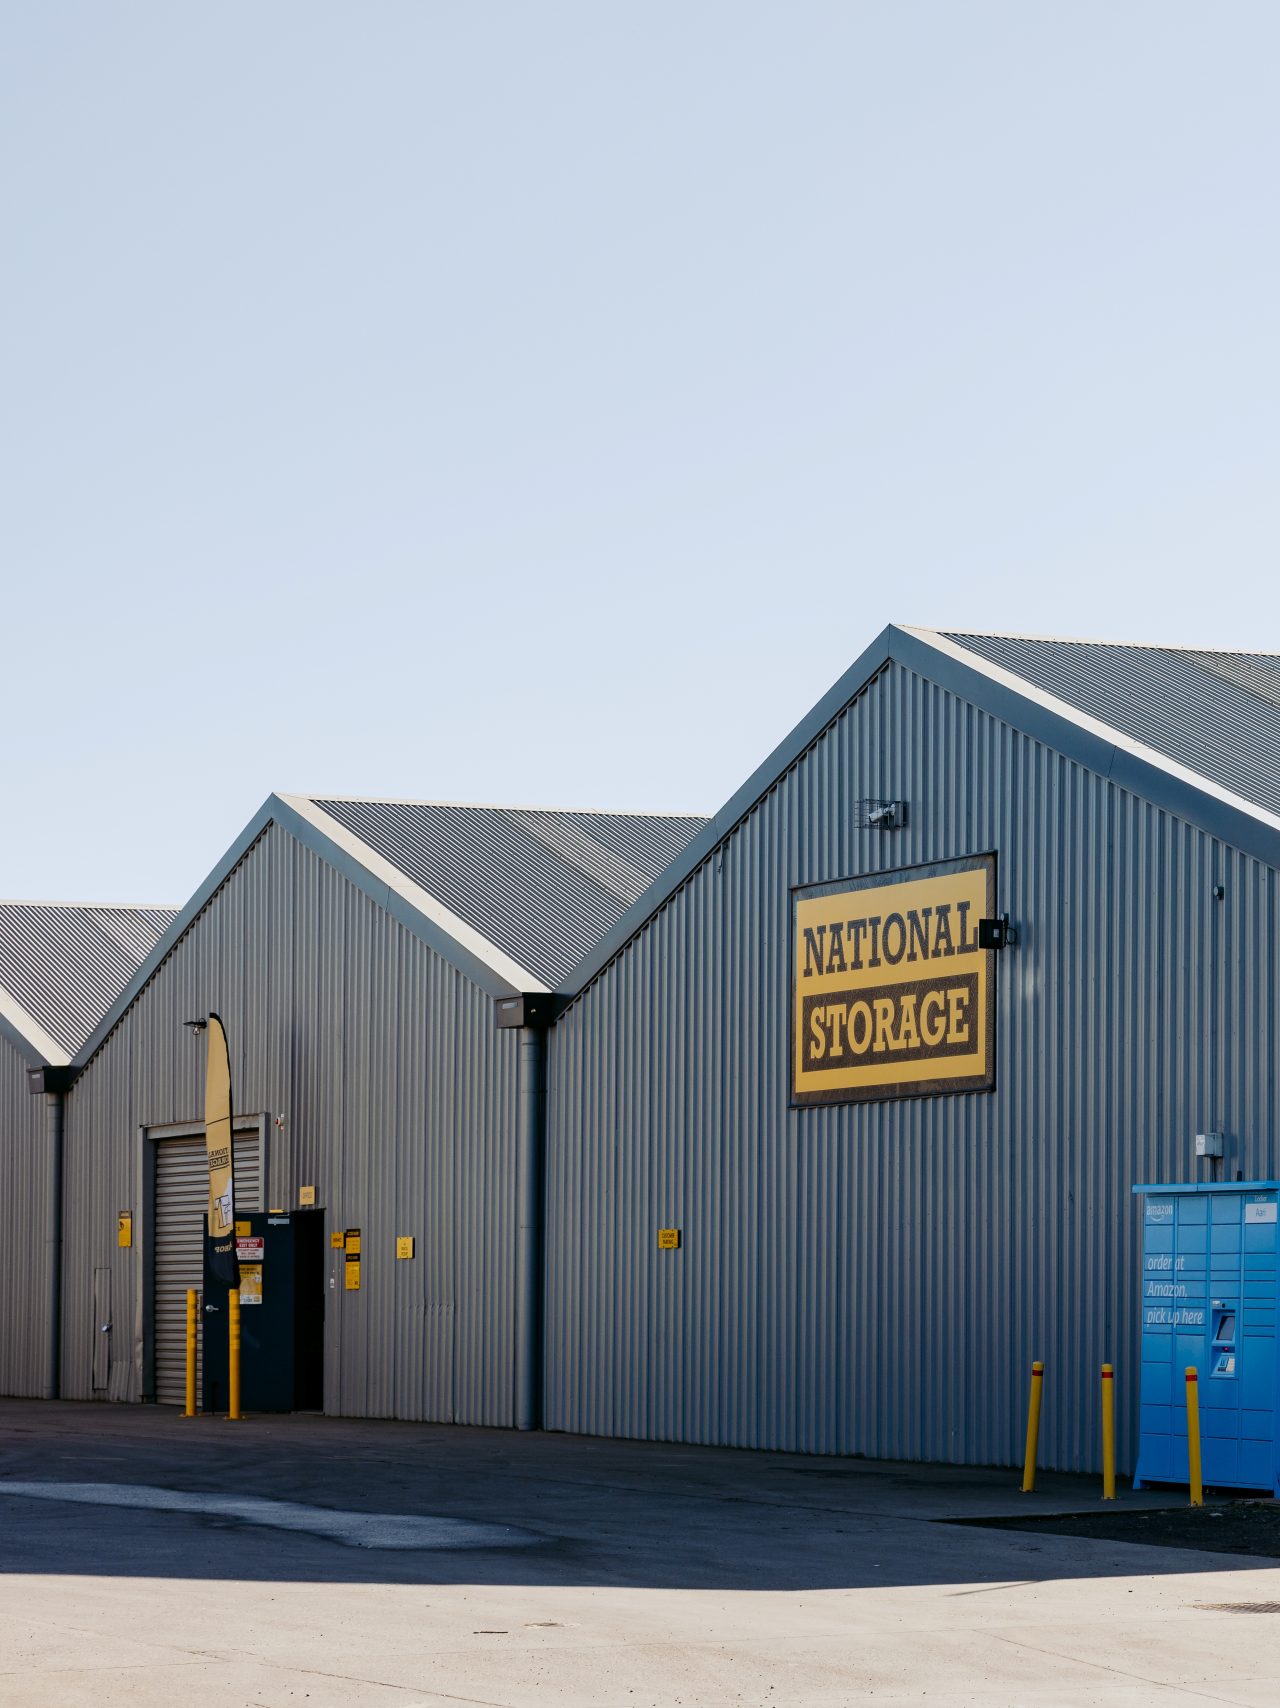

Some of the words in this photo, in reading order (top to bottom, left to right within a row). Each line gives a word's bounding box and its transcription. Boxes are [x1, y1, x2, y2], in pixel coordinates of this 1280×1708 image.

[803, 901, 979, 978] NATIONAL
[810, 987, 969, 1059] STORAGE
[1146, 1204, 1173, 1216] amazon
[1147, 1254, 1173, 1271] order
[1175, 1256, 1185, 1271] at
[1147, 1280, 1188, 1300] Amazon,
[1146, 1307, 1166, 1327] pick
[1168, 1311, 1180, 1328] up
[1181, 1307, 1203, 1325] here
